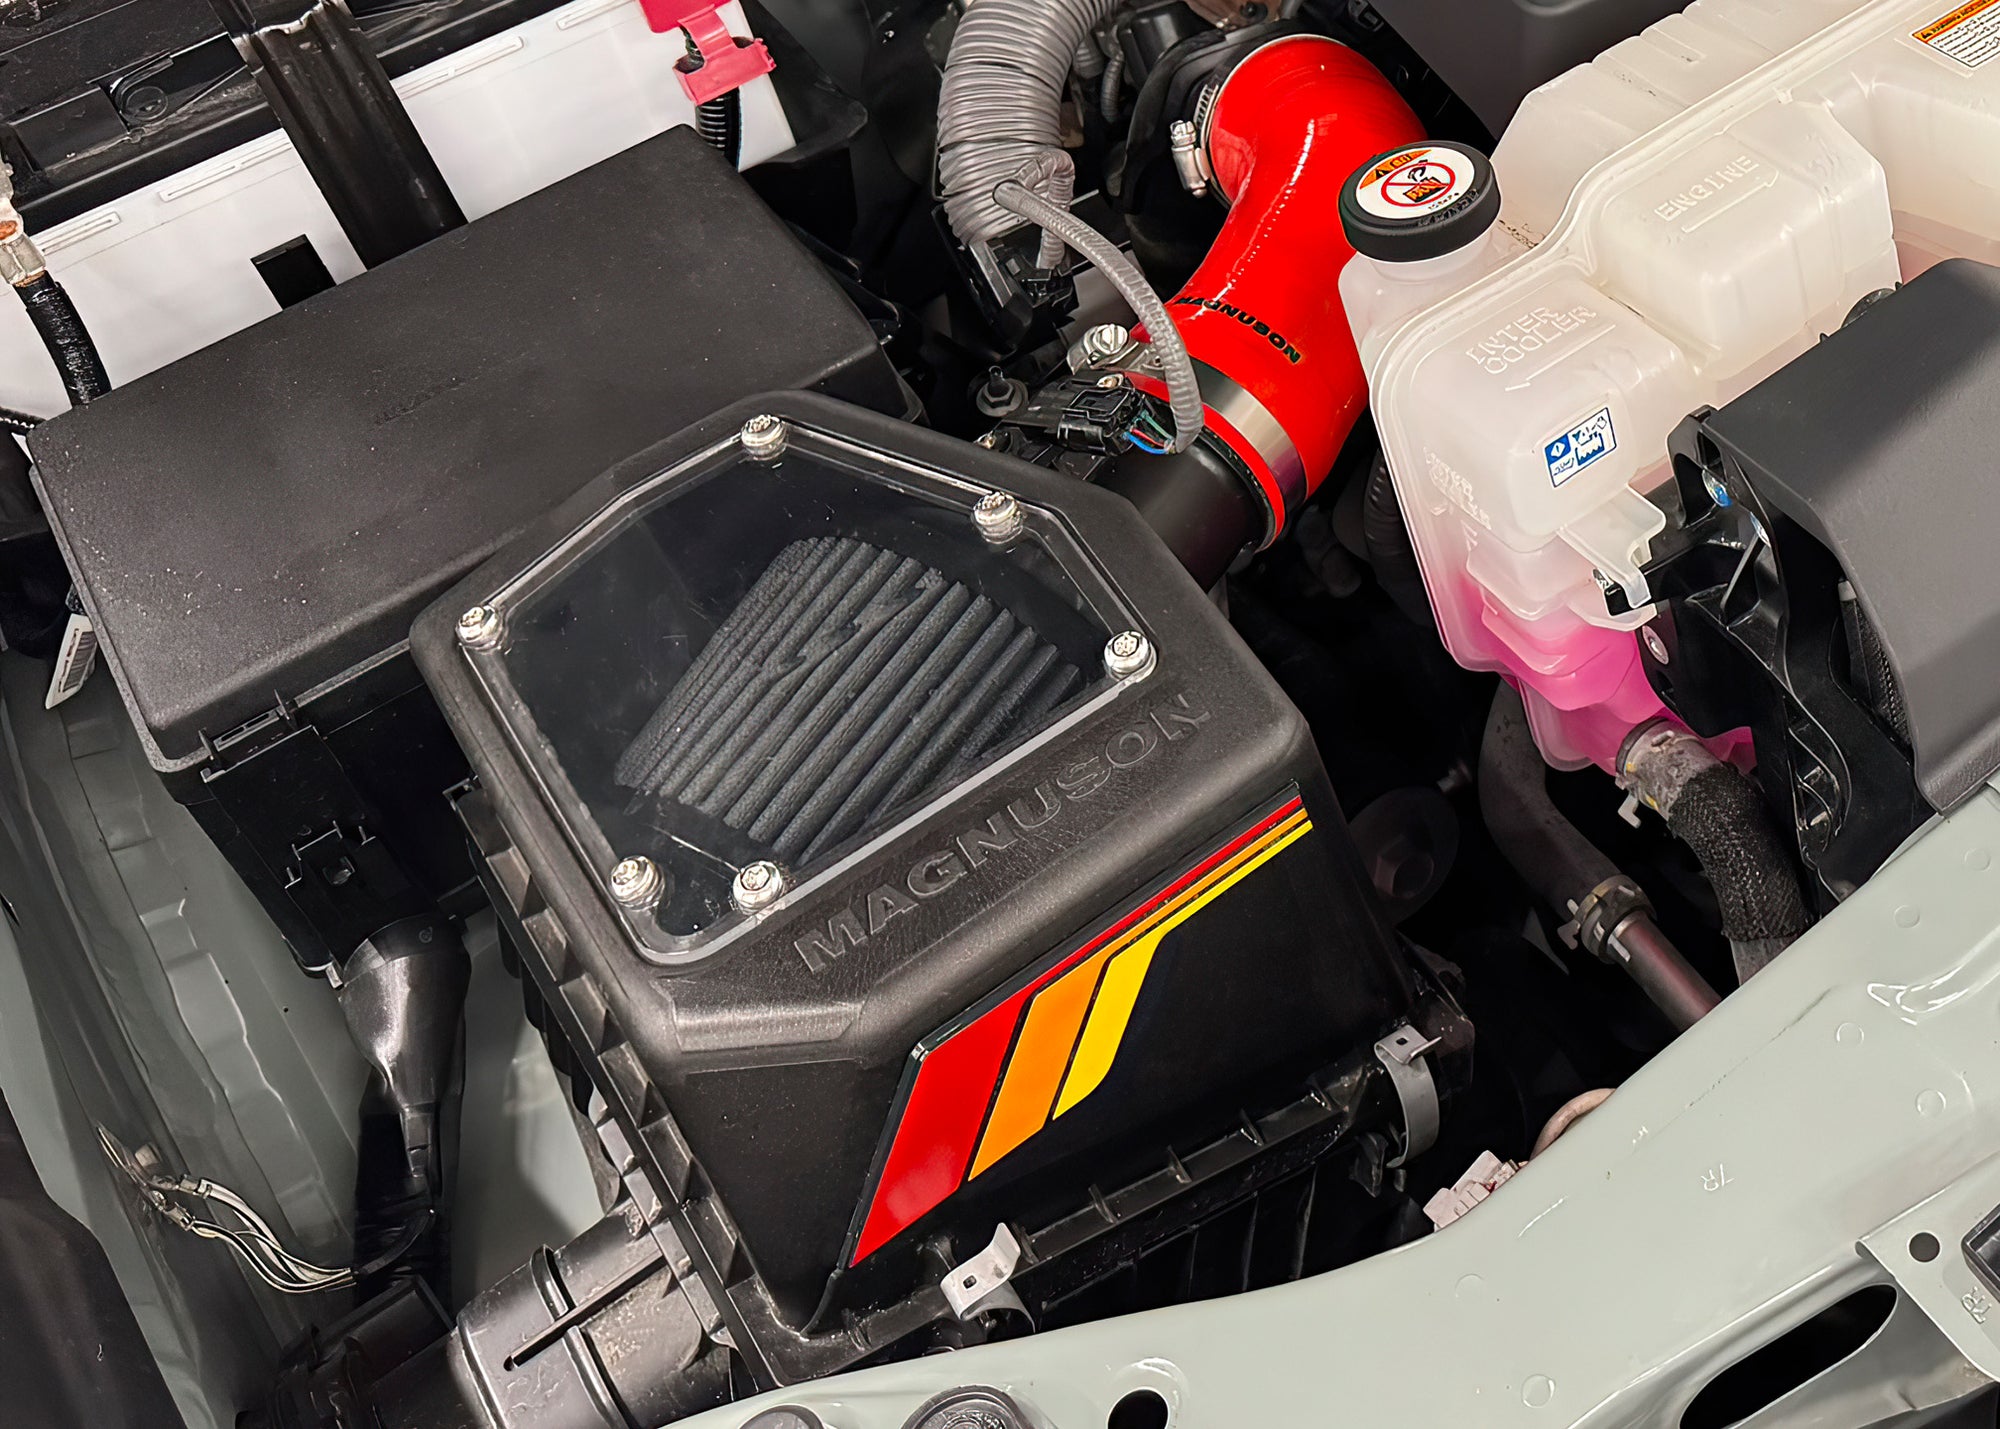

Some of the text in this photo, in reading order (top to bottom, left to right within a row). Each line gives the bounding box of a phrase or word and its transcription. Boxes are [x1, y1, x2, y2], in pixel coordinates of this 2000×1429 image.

[1654, 155, 1760, 221] ENGINE
[1465, 306, 1560, 365] INTER
[1483, 305, 1597, 374] COOLER
[793, 692, 1211, 974] MAGNUSON
